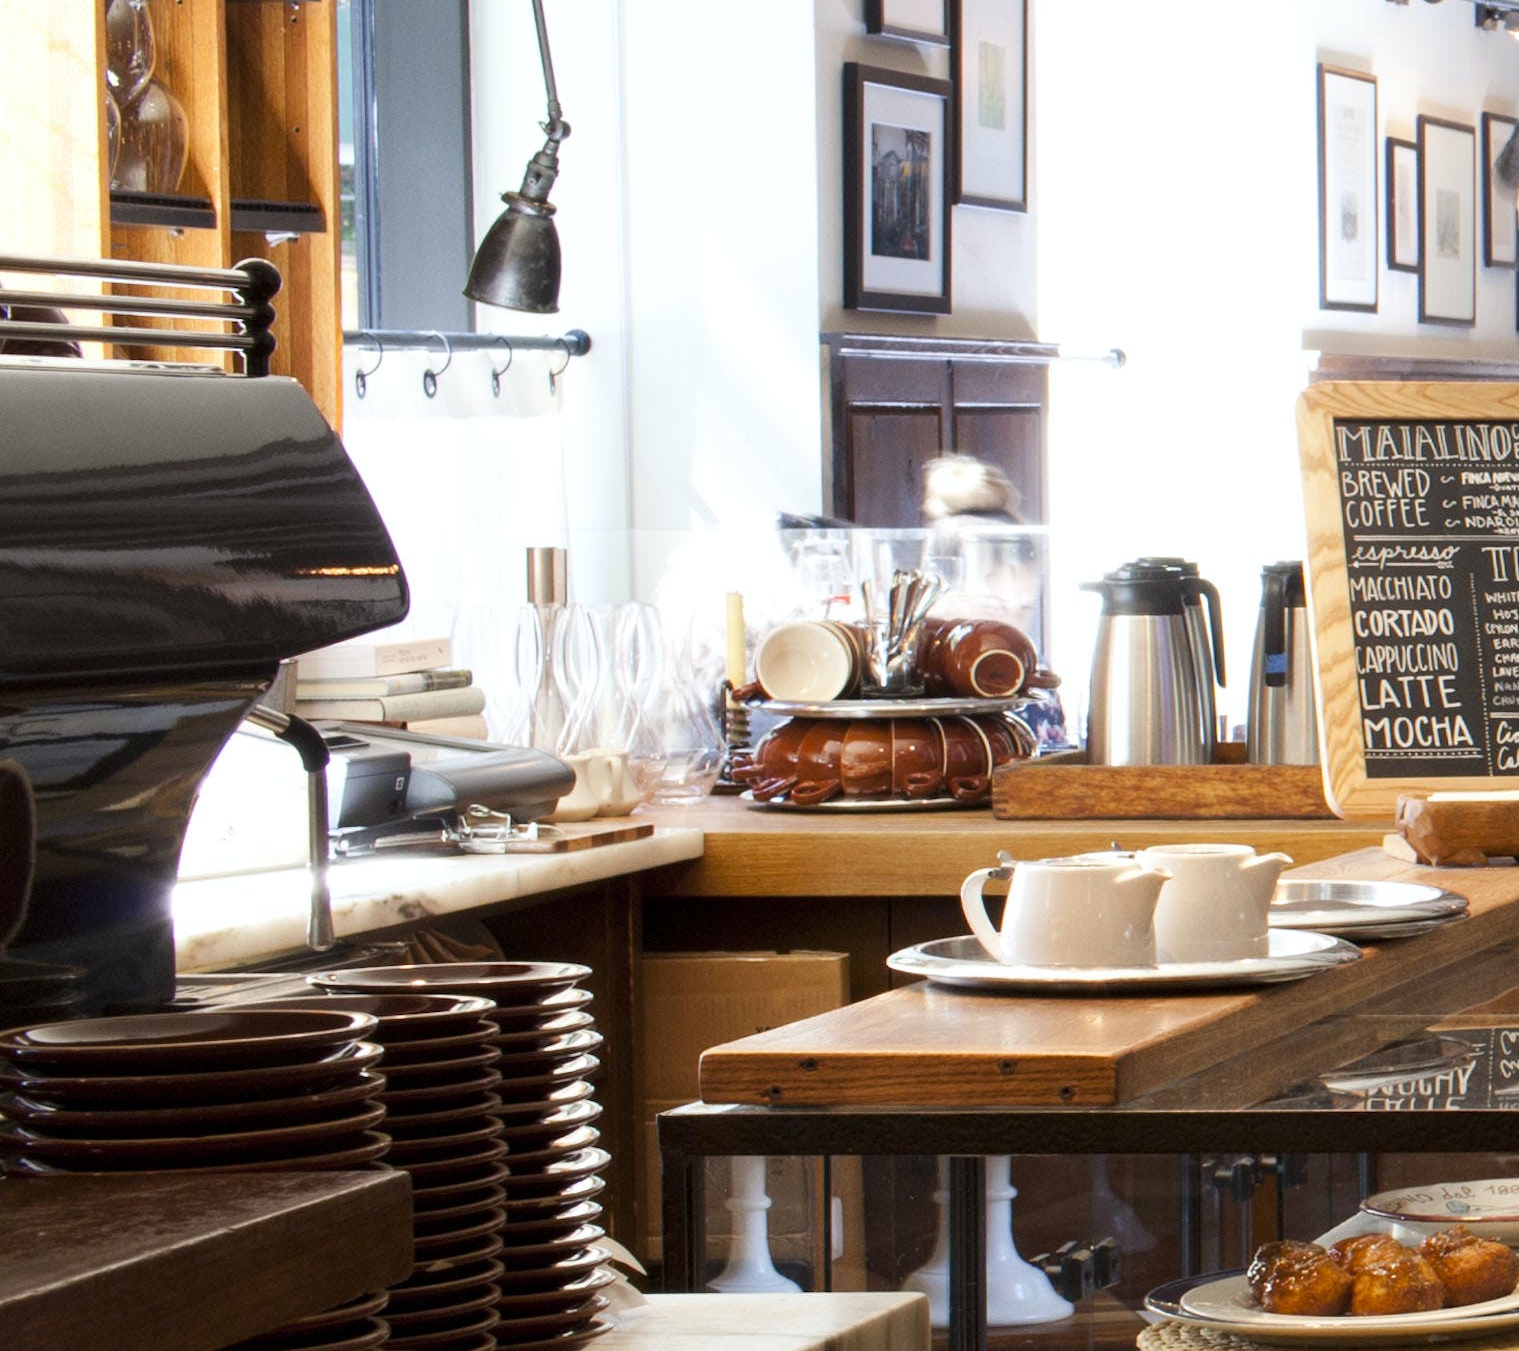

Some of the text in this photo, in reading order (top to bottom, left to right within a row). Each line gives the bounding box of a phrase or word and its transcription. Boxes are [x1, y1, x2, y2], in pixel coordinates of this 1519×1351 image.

[1336, 425, 1512, 462] MAIALINO
[1342, 469, 1431, 499] BREWED
[1345, 499, 1431, 529] COFFEE
[1462, 494, 1500, 510] FINCA
[1351, 545, 1461, 570] espresso
[1350, 575, 1452, 602] MACCHIATO
[1354, 608, 1455, 638] CORTADO
[1355, 642, 1459, 675] CAPPUCCINO
[1360, 675, 1462, 710] LATTE
[1364, 714, 1475, 748] MOCHA
